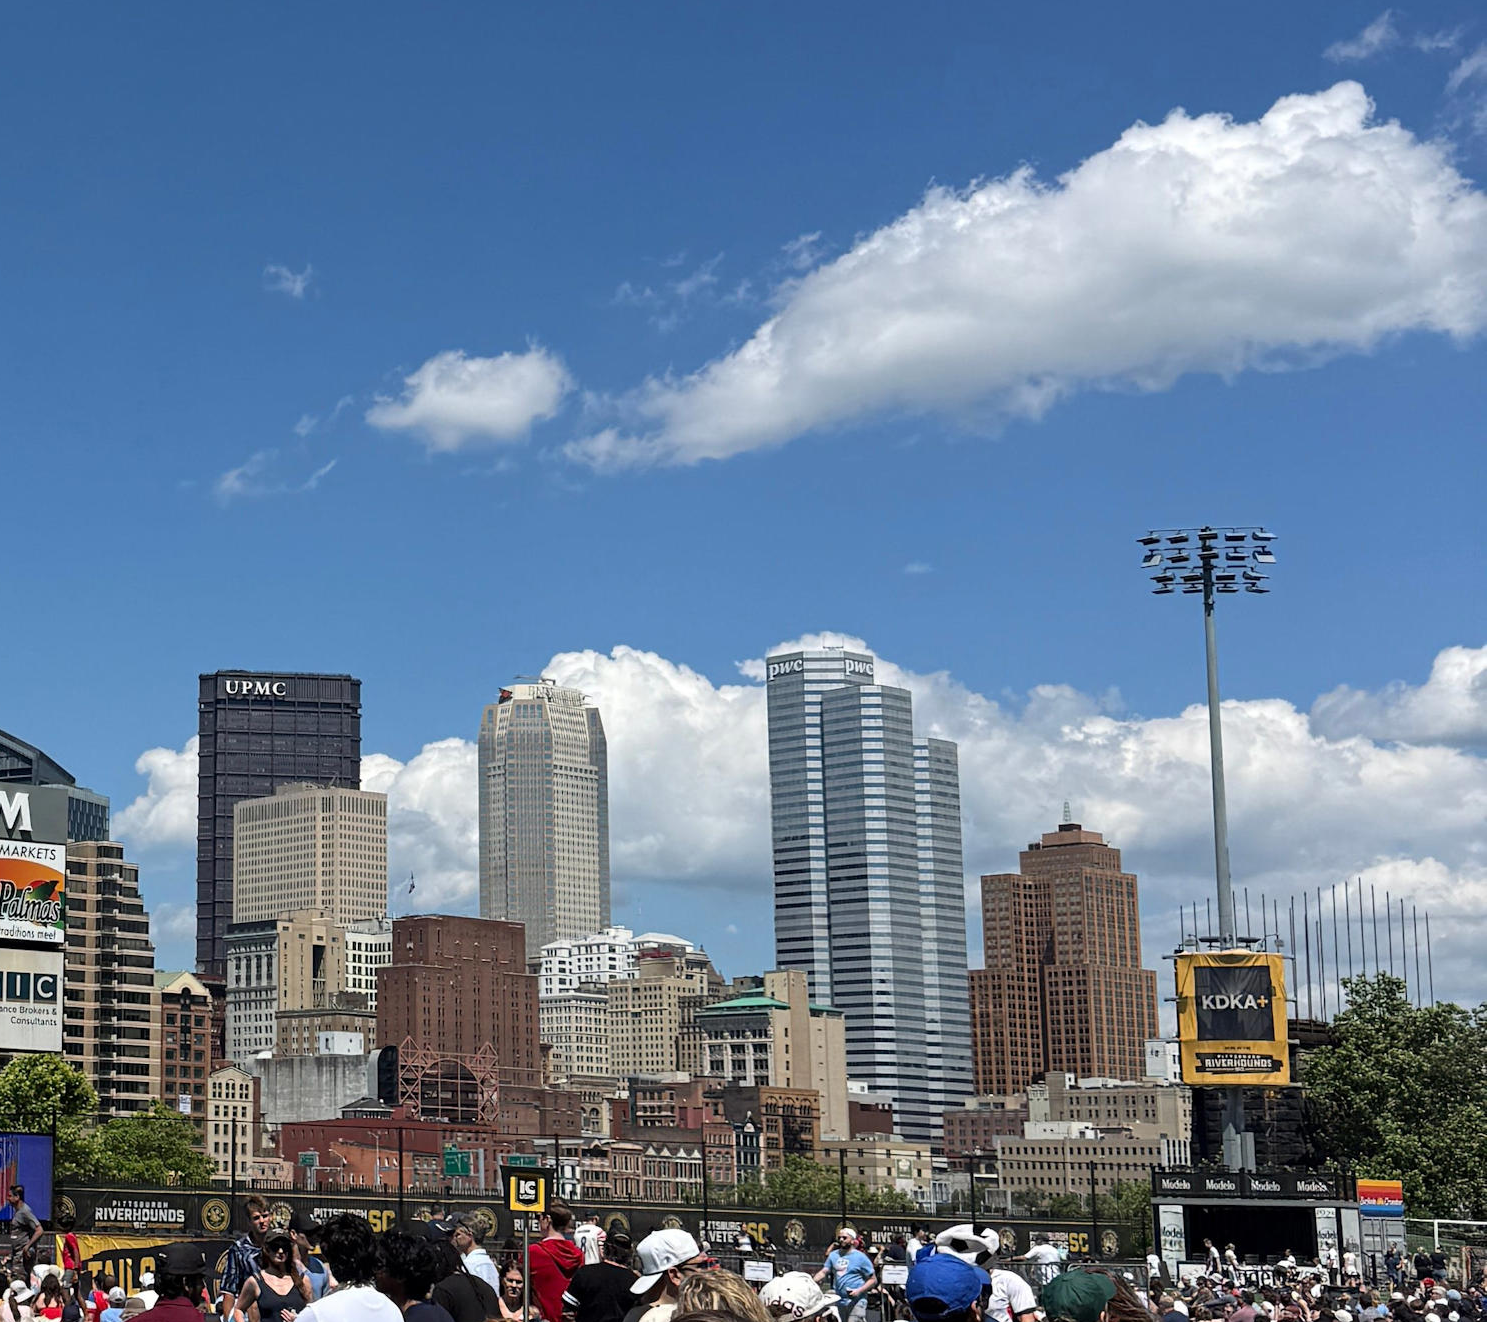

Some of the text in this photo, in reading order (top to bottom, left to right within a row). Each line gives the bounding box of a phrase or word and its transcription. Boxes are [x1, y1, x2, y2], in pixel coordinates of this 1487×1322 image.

[769, 660, 802, 681] pwc
[845, 660, 873, 676] pwc
[225, 680, 286, 696] UPMC
[37, 930, 56, 940] meet
[1201, 994, 1268, 1010] KDKA+
[19, 1006, 49, 1015] Brokers
[11, 1016, 57, 1026] Consultants
[1205, 1058, 1272, 1068] RIVERHOUNDS
[519, 1180, 536, 1194] IC
[1162, 1178, 1191, 1190] Modelo
[1206, 1179, 1235, 1191] Modelo
[1251, 1179, 1280, 1192] Modelo
[95, 1207, 185, 1222] RIVERHOUNDS
[313, 1207, 367, 1219] PITTSRGH
[368, 1209, 395, 1232] SC
[1069, 1232, 1089, 1253] SC
